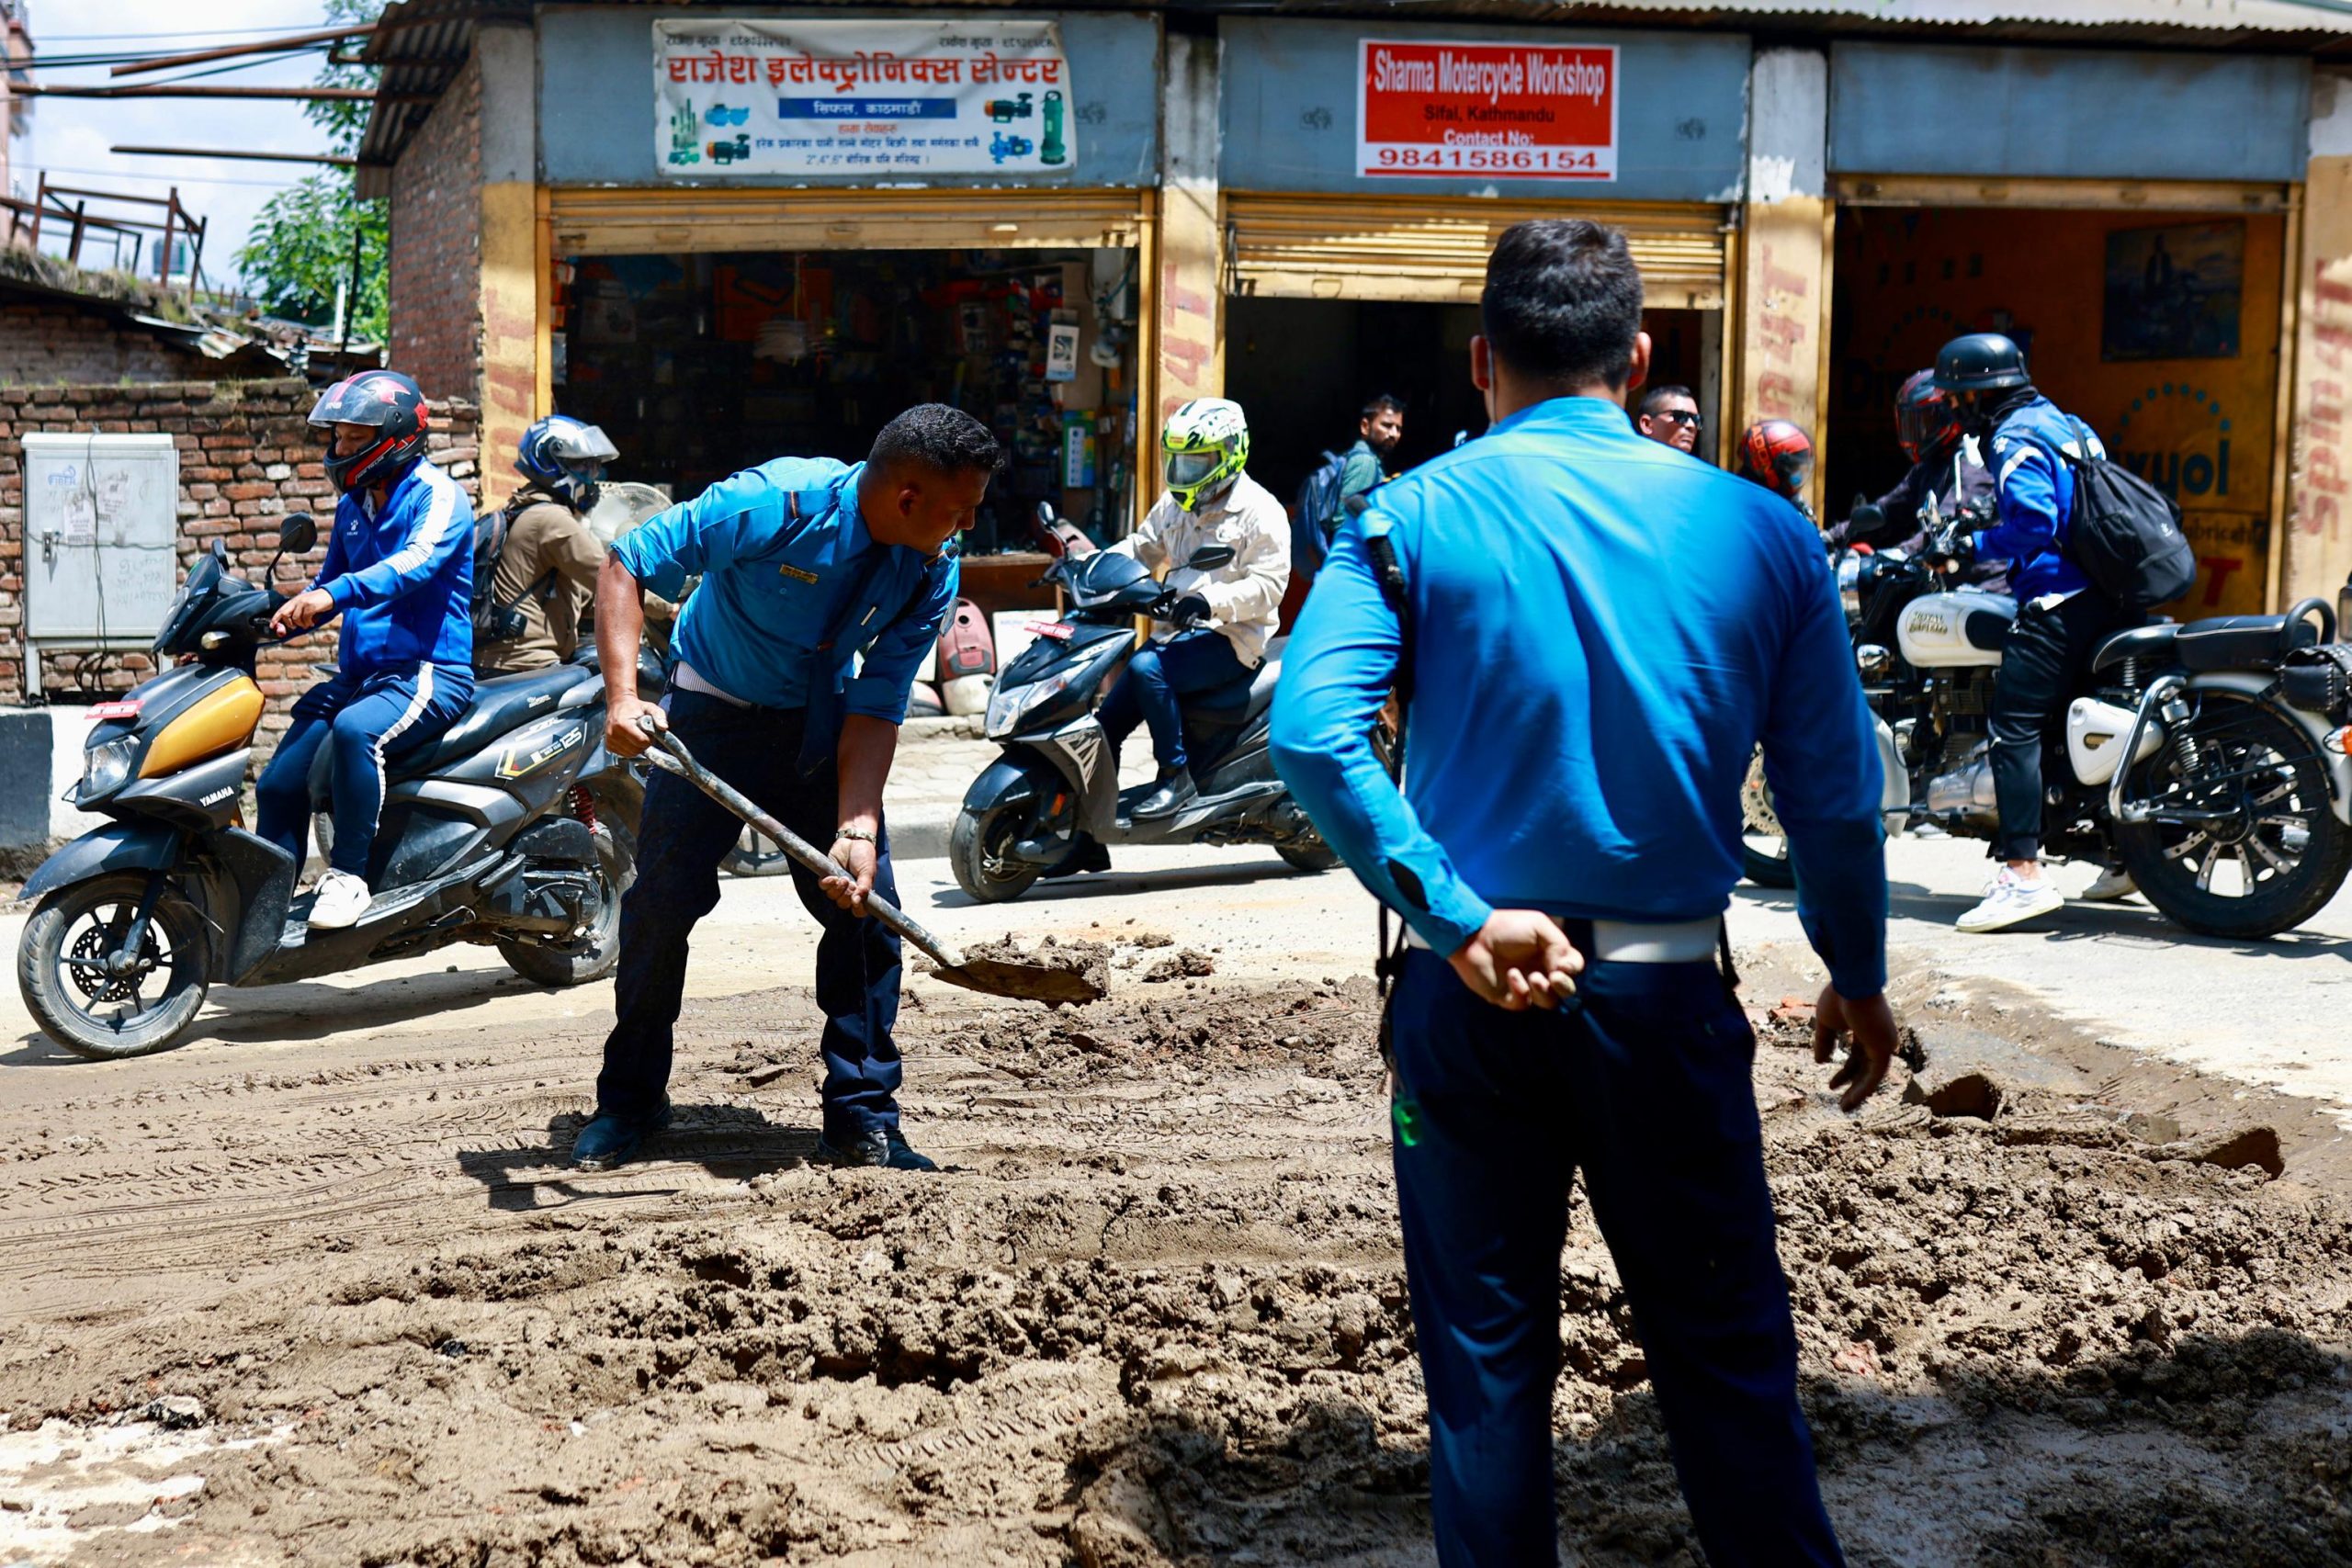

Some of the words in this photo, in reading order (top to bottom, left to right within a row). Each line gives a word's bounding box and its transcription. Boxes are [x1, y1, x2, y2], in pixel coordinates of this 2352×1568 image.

[667, 50, 759, 85] राजेश
[766, 50, 964, 93] इलेक्ट्रोनिक्स
[970, 51, 1062, 85] सेन्टर
[1374, 49, 1434, 93] Sharma
[1527, 52, 1605, 107] Workshop
[1424, 105, 1463, 122] Sifal,
[1467, 106, 1555, 123] Kathmandu
[1443, 128, 1504, 146] Contact
[1507, 130, 1534, 147] No:
[1378, 148, 1597, 169] 9841586154
[2297, 378, 2349, 542] Spin
[559, 727, 582, 750] 125
[199, 785, 235, 807] YAMAHA
